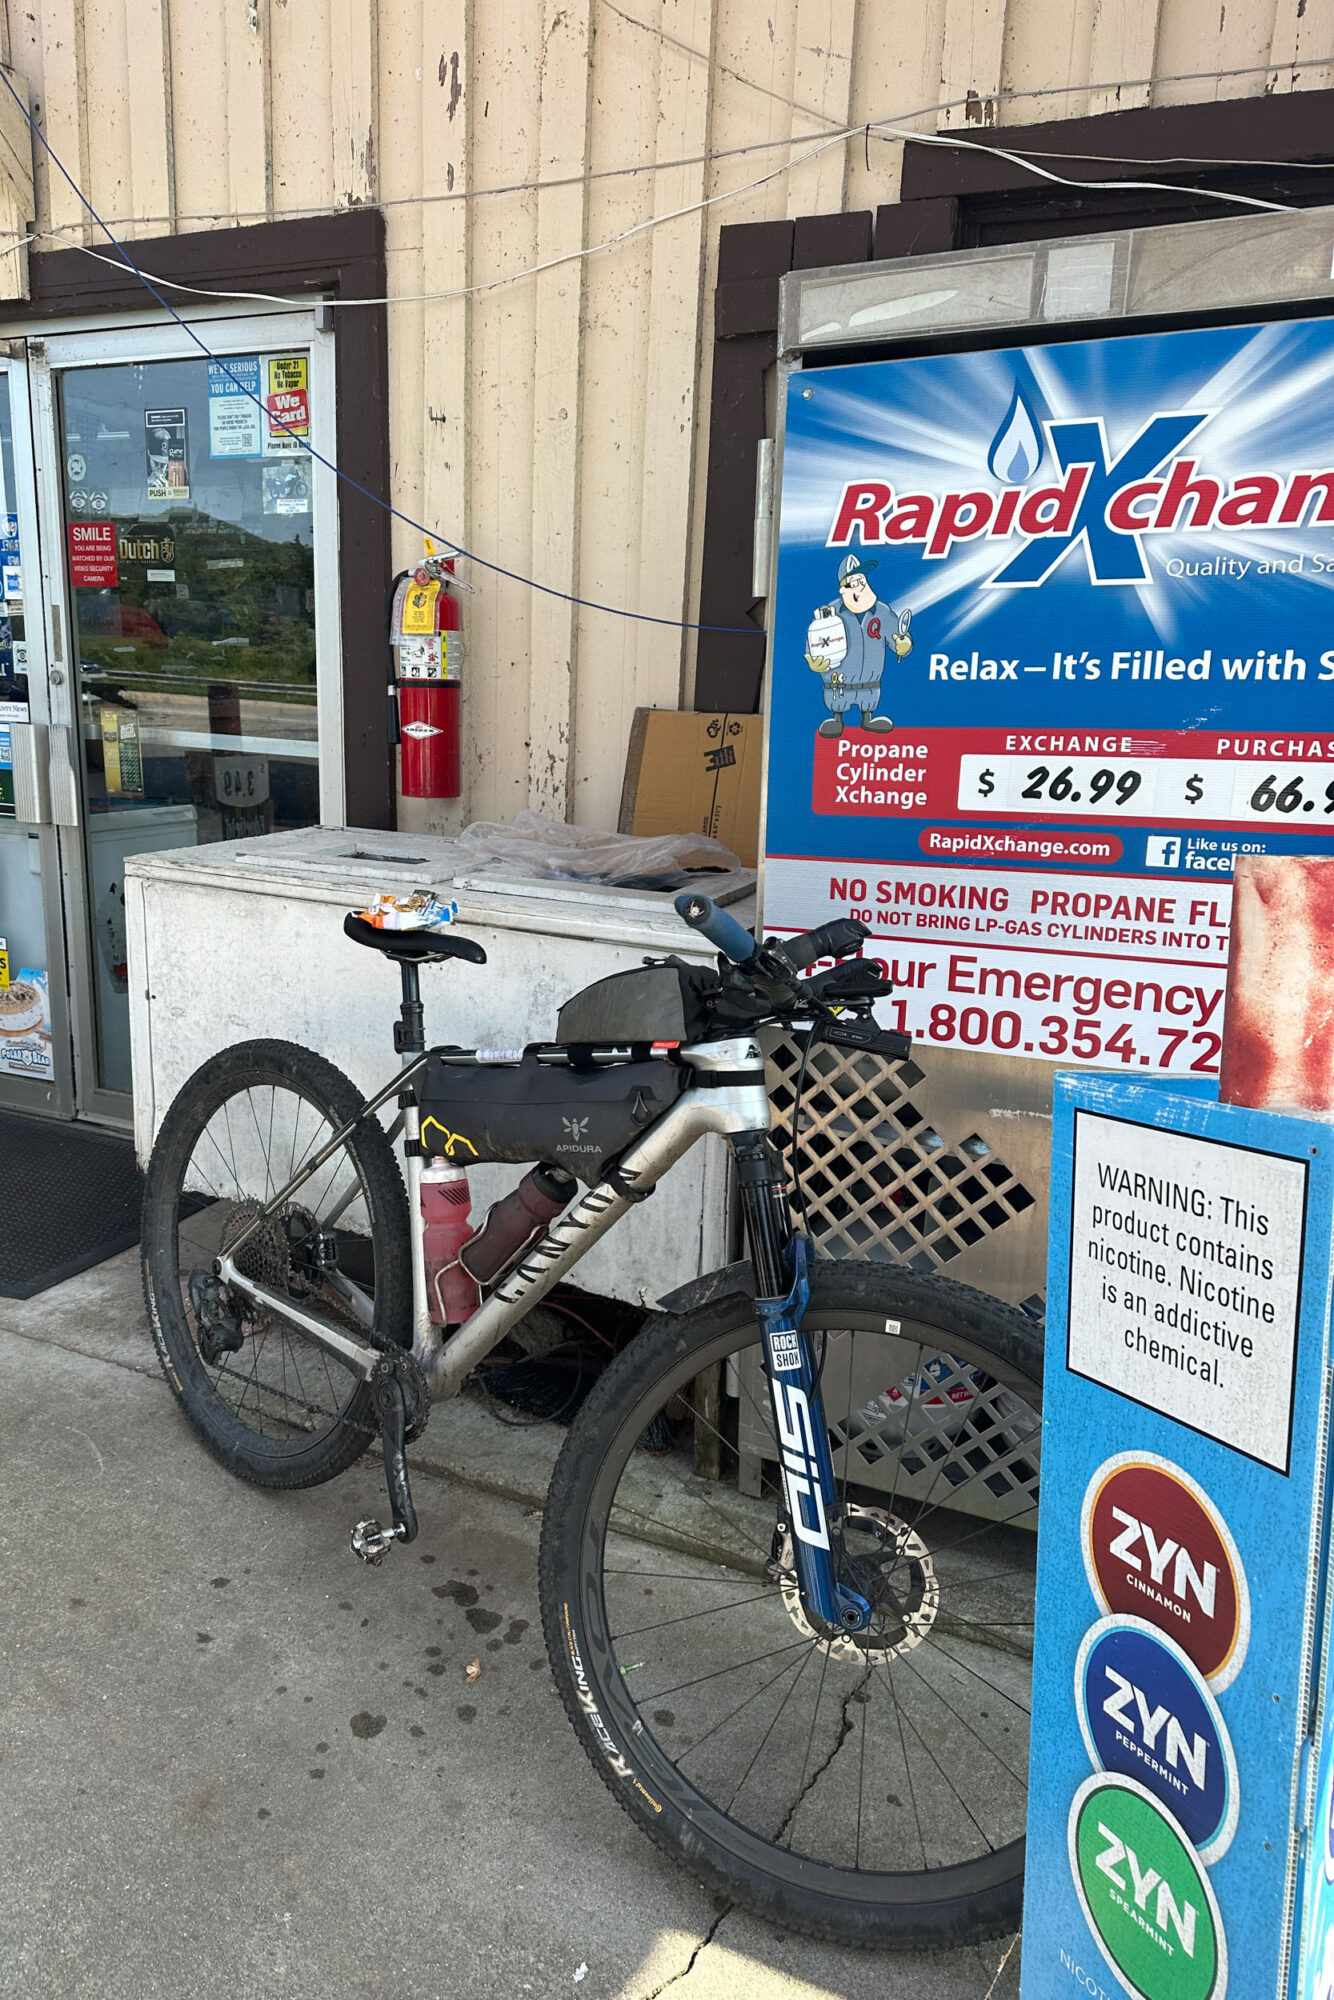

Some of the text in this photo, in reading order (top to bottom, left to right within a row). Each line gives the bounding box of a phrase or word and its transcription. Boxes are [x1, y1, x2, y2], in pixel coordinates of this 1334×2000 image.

[230, 361, 257, 373] SERIOUS
[293, 360, 299, 369] 21
[211, 383, 223, 394] YOU
[225, 382, 239, 393] CAN
[274, 394, 300, 409] We
[270, 406, 306, 425] Card
[149, 489, 167, 497] PUSH
[73, 527, 112, 541] SMILE
[119, 538, 159, 560] Dutch
[1166, 557, 1251, 580] Quality
[1256, 553, 1304, 574] and
[867, 617, 882, 640] Q
[1112, 650, 1211, 682] Filled
[1222, 649, 1307, 682] with
[837, 739, 929, 761] Propane
[1005, 735, 1133, 755] EXCHANGE
[836, 762, 928, 784] Cylinder
[978, 765, 1142, 806] $ 26.99
[1185, 773, 1205, 805] $
[835, 785, 928, 807] Xchange
[929, 833, 1111, 857] RapidXchange.com
[1187, 837, 1267, 853] Like us on:
[829, 877, 1010, 912] NO SMOKING
[1030, 890, 1231, 928] PROPANE FL
[849, 907, 872, 924] DO
[877, 909, 911, 927] NOT
[916, 912, 971, 931] BRING
[975, 915, 1043, 936] LP-GAS
[1046, 921, 1158, 946] CYLINDERS
[1162, 930, 1211, 950] INTO
[948, 954, 1225, 1028] Emergency
[556, 1144, 602, 1153] APIDURA
[1097, 1161, 1270, 1236] WARNING: This
[494, 1165, 643, 1304] CANYON
[1092, 1204, 1274, 1281] product contains
[1088, 1238, 1275, 1324] nicotine. Nicotine
[1102, 1276, 1254, 1359] is an addictive
[773, 1333, 798, 1351] ROCK
[1124, 1326, 1225, 1389] chemical.
[776, 1351, 800, 1367] SHOX
[1108, 1505, 1218, 1620] ZYN
[1126, 1573, 1192, 1624] CINNAMON
[571, 1655, 600, 1715] KING
[1102, 1664, 1208, 1792] ZYN
[589, 1712, 635, 1778] RACE
[1115, 1729, 1189, 1796] PEPPERMINT
[1095, 1820, 1197, 1959] ZYN
[1109, 1888, 1175, 1957] SPEARMINT
[1060, 1948, 1111, 2000] NICOT
